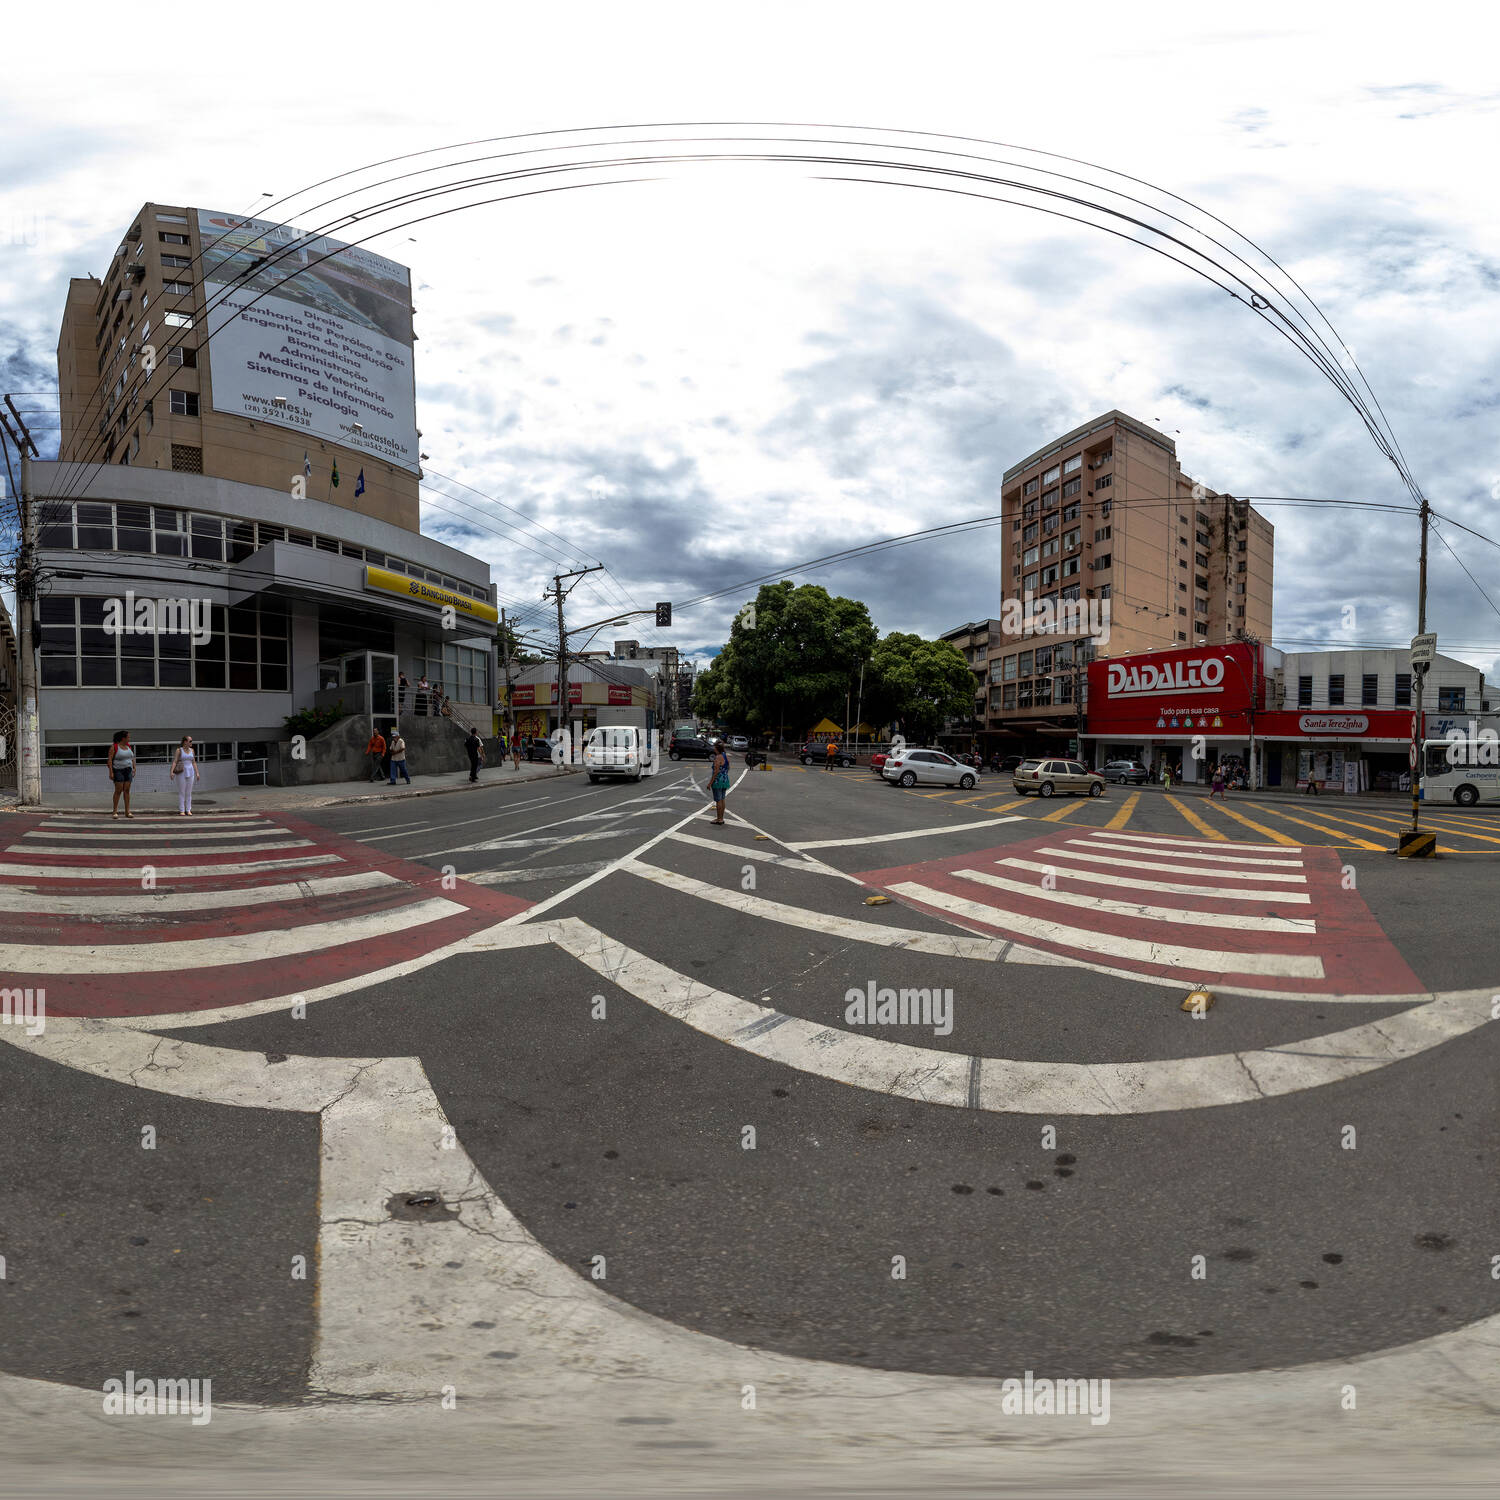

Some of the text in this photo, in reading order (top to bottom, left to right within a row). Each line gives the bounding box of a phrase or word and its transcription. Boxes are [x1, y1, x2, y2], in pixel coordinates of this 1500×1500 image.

[220, 300, 303, 326] Engenharia
[307, 320, 323, 332] de
[326, 328, 373, 352] Petróleo
[385, 351, 405, 366] Gás
[304, 310, 344, 330] Direito
[241, 313, 393, 371] Engenharia de Produção
[287, 335, 361, 369] Biomedicina
[258, 351, 385, 403] Medicina Veterinária
[280, 345, 368, 383] Administração
[246, 360, 394, 419] Sistemas de Informação
[298, 388, 359, 418] Psicologia
[421, 586, 472, 610] BANCO DO BRASIL
[1108, 658, 1225, 693] DADALTO
[1176, 708, 1189, 716] para
[1304, 718, 1363, 729] Santa Terezinha
